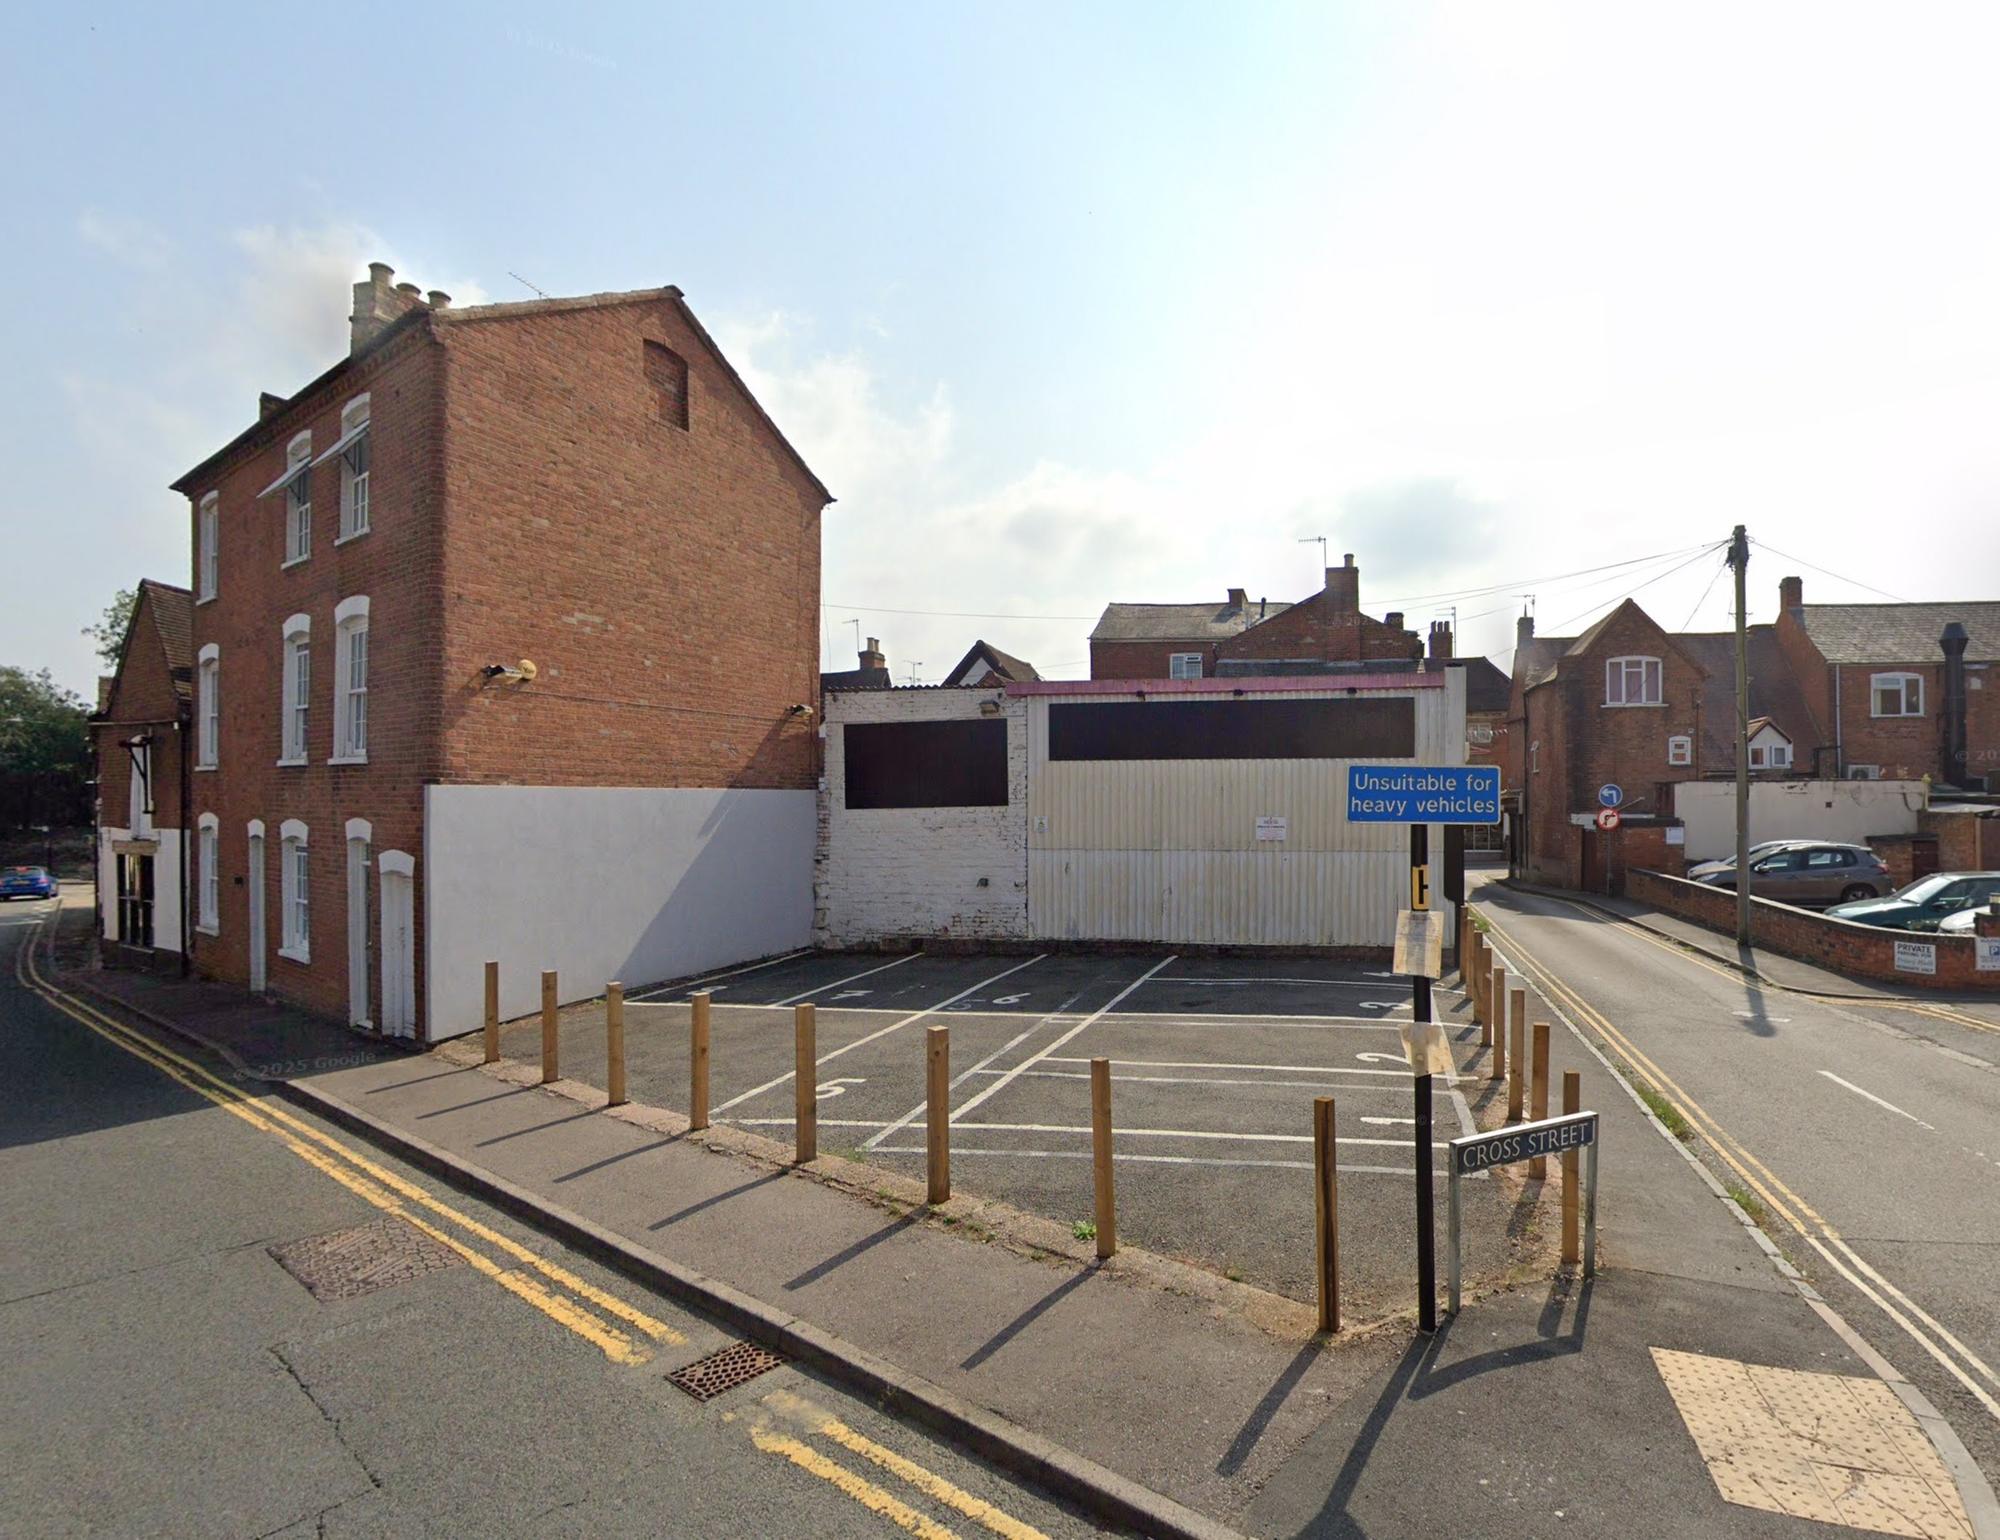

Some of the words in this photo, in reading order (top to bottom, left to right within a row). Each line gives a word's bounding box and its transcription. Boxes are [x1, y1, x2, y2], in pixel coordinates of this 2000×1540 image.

[1355, 773, 1456, 791] Unsuitable
[1466, 775, 1492, 791] for
[1351, 796, 1407, 816] heavy
[1416, 797, 1495, 814] vehicles
[1897, 943, 1931, 953] PRIVATE
[992, 992, 1031, 1004] 6
[1358, 1001, 1412, 1010] 3
[815, 1078, 867, 1099] 5
[1463, 1137, 1520, 1167] CROSS
[1528, 1123, 1588, 1154] STREET
